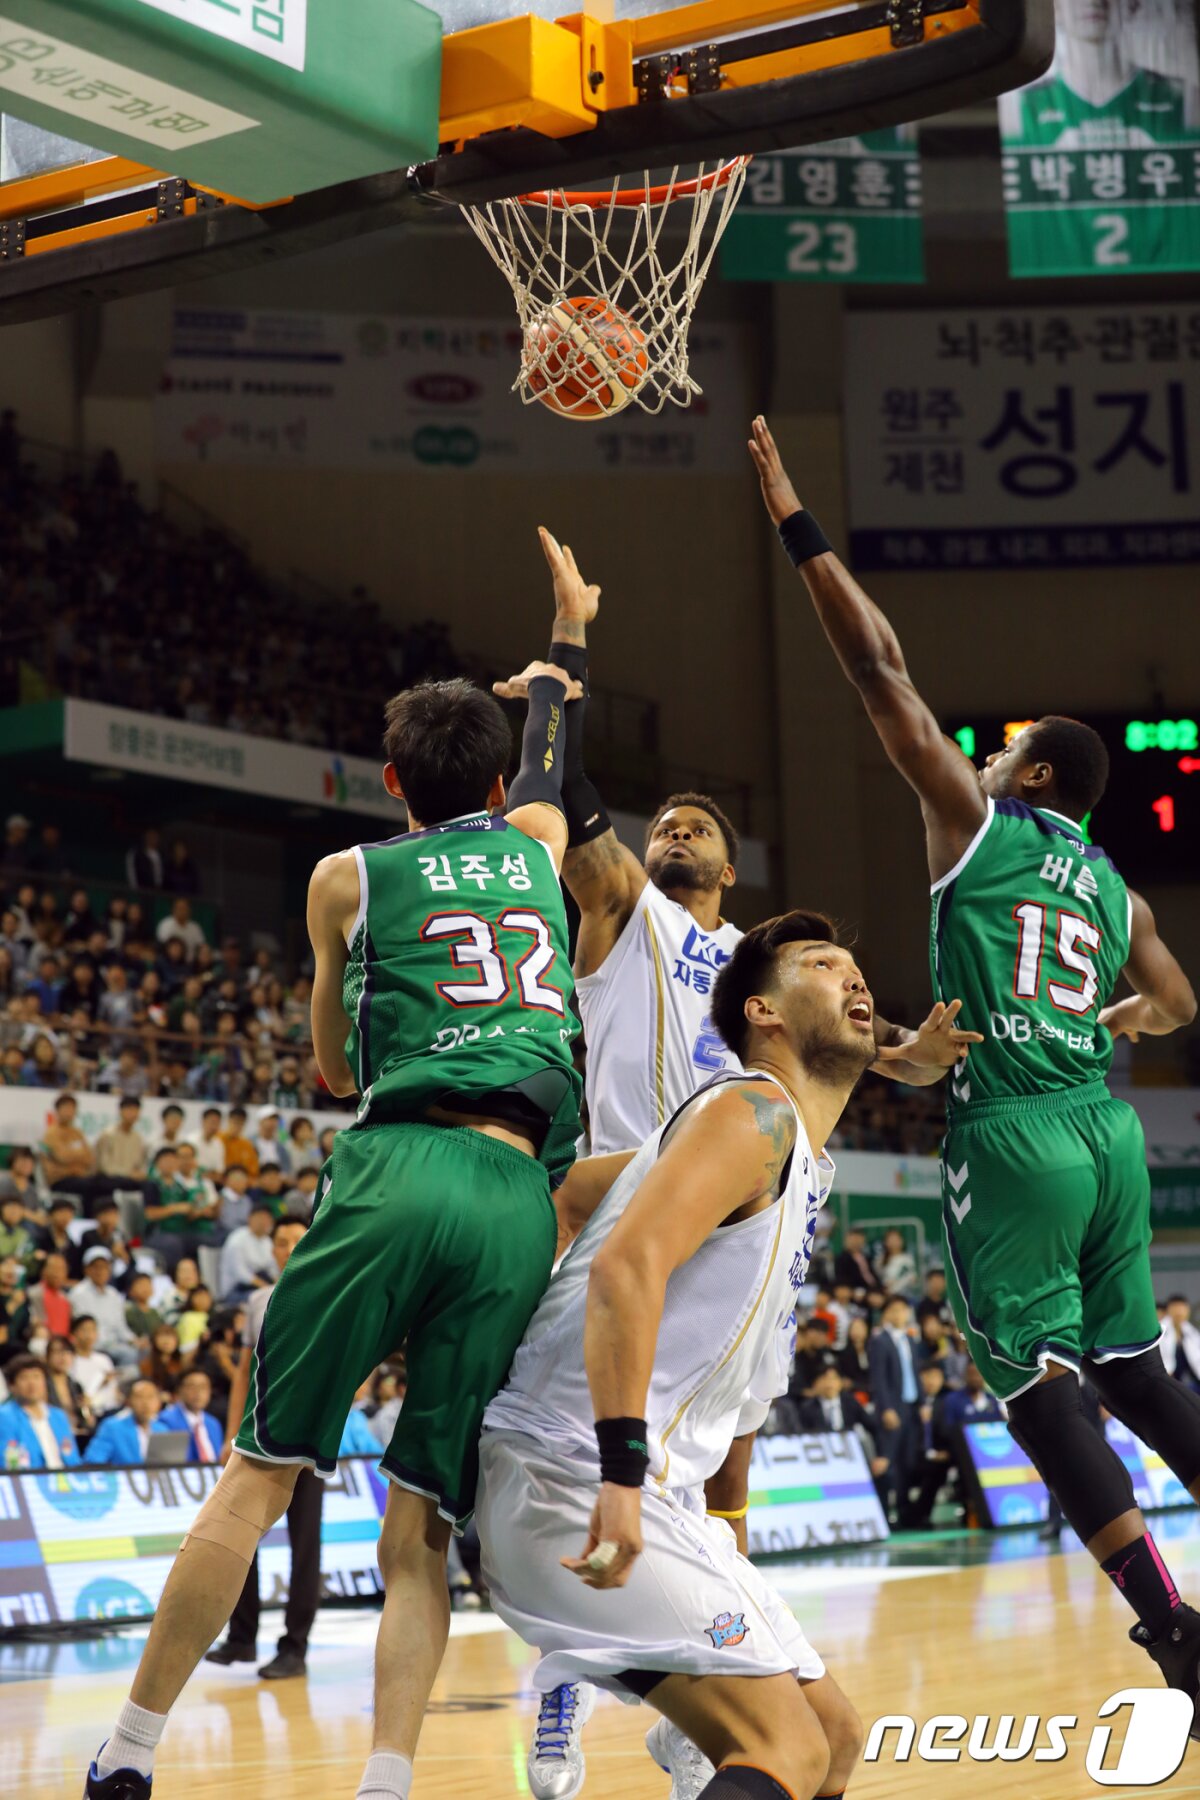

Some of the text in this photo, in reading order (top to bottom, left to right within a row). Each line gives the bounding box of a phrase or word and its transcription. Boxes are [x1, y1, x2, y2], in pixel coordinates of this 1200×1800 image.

[1030, 152, 1182, 199] 박병우
[785, 221, 858, 273] 23
[1093, 214, 1131, 265] 2
[881, 386, 964, 432] 원주
[417, 853, 533, 892] 김주성
[418, 907, 566, 1020] 32
[1012, 900, 1103, 1016] 15
